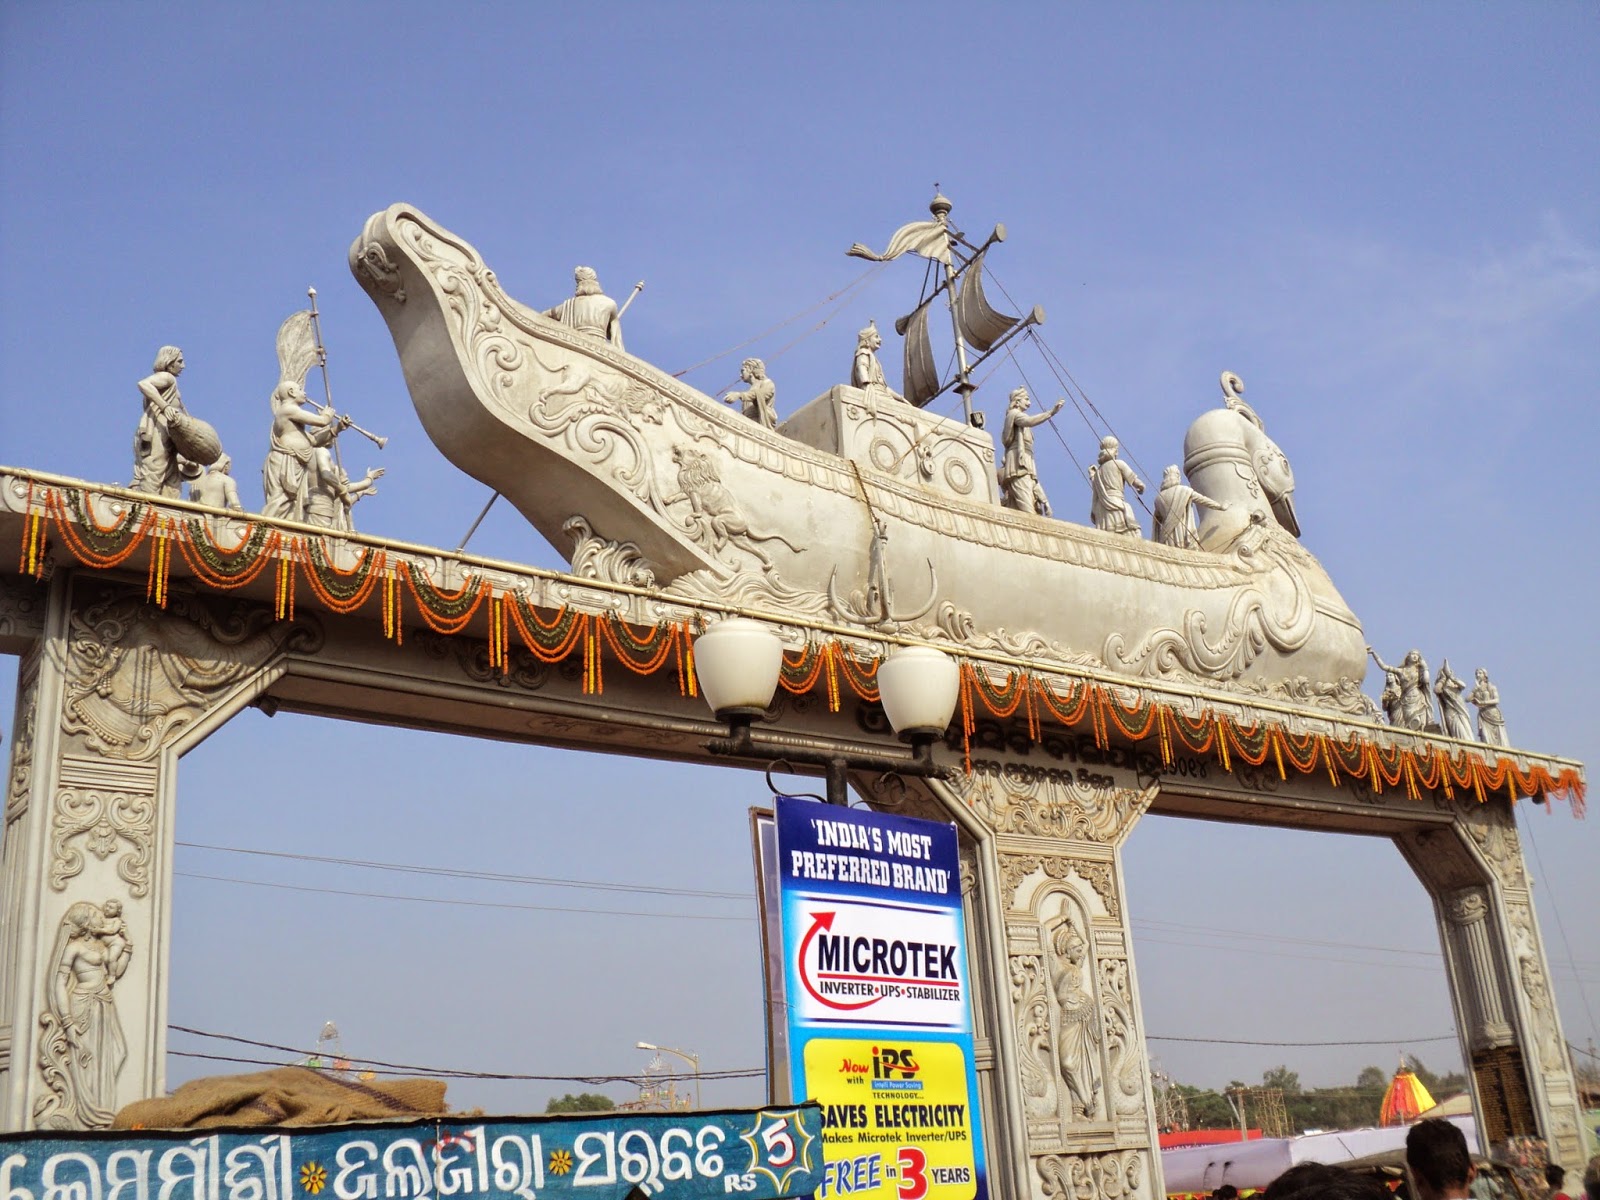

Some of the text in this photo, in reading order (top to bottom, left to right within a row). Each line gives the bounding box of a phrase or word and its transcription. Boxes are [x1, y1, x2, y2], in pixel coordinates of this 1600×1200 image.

[886, 830, 932, 860] MOST
[791, 850, 890, 887] PREFERRED
[818, 934, 958, 980] MICROTEK
[839, 1046, 916, 1079] Now iPS
[847, 1076, 864, 1084] with
[905, 1081, 921, 1090] Saving
[875, 1104, 965, 1128] ELECTRICITY
[858, 1131, 901, 1143] Microtek
[906, 1131, 966, 1142] Inverter/UPS
[725, 1119, 796, 1193] RS 5
[820, 1148, 970, 1200] FREE in 3 YEARS
